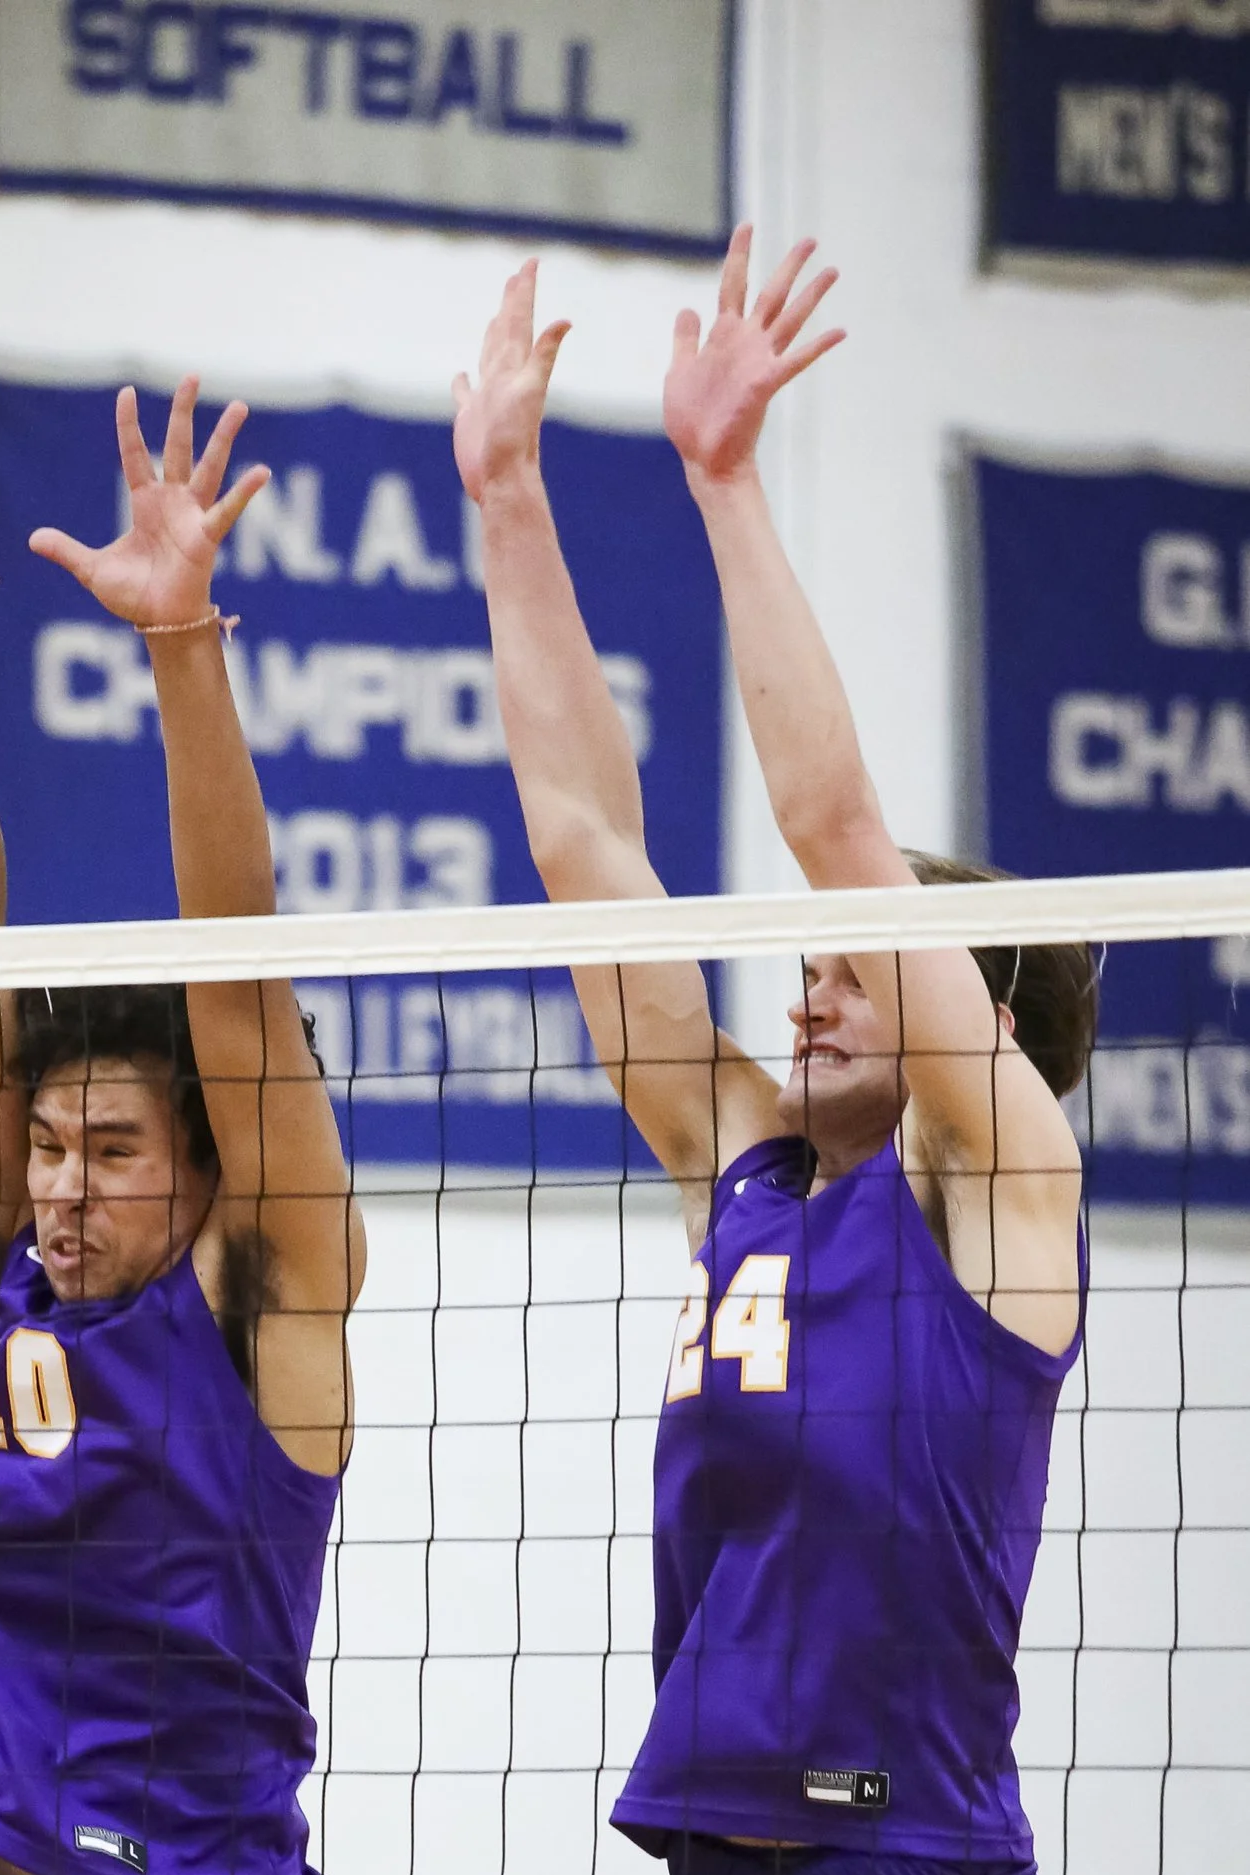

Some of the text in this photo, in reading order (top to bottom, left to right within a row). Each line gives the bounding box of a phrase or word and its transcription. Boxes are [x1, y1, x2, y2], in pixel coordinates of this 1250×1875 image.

[66, 0, 632, 148] SOFTBALL
[32, 620, 655, 768] CHMPIOS
[1048, 690, 1250, 814] CHA
[262, 806, 492, 912] 013
[666, 1253, 792, 1404] 24
[129, 1842, 140, 1860] L
[863, 1780, 880, 1799] M
